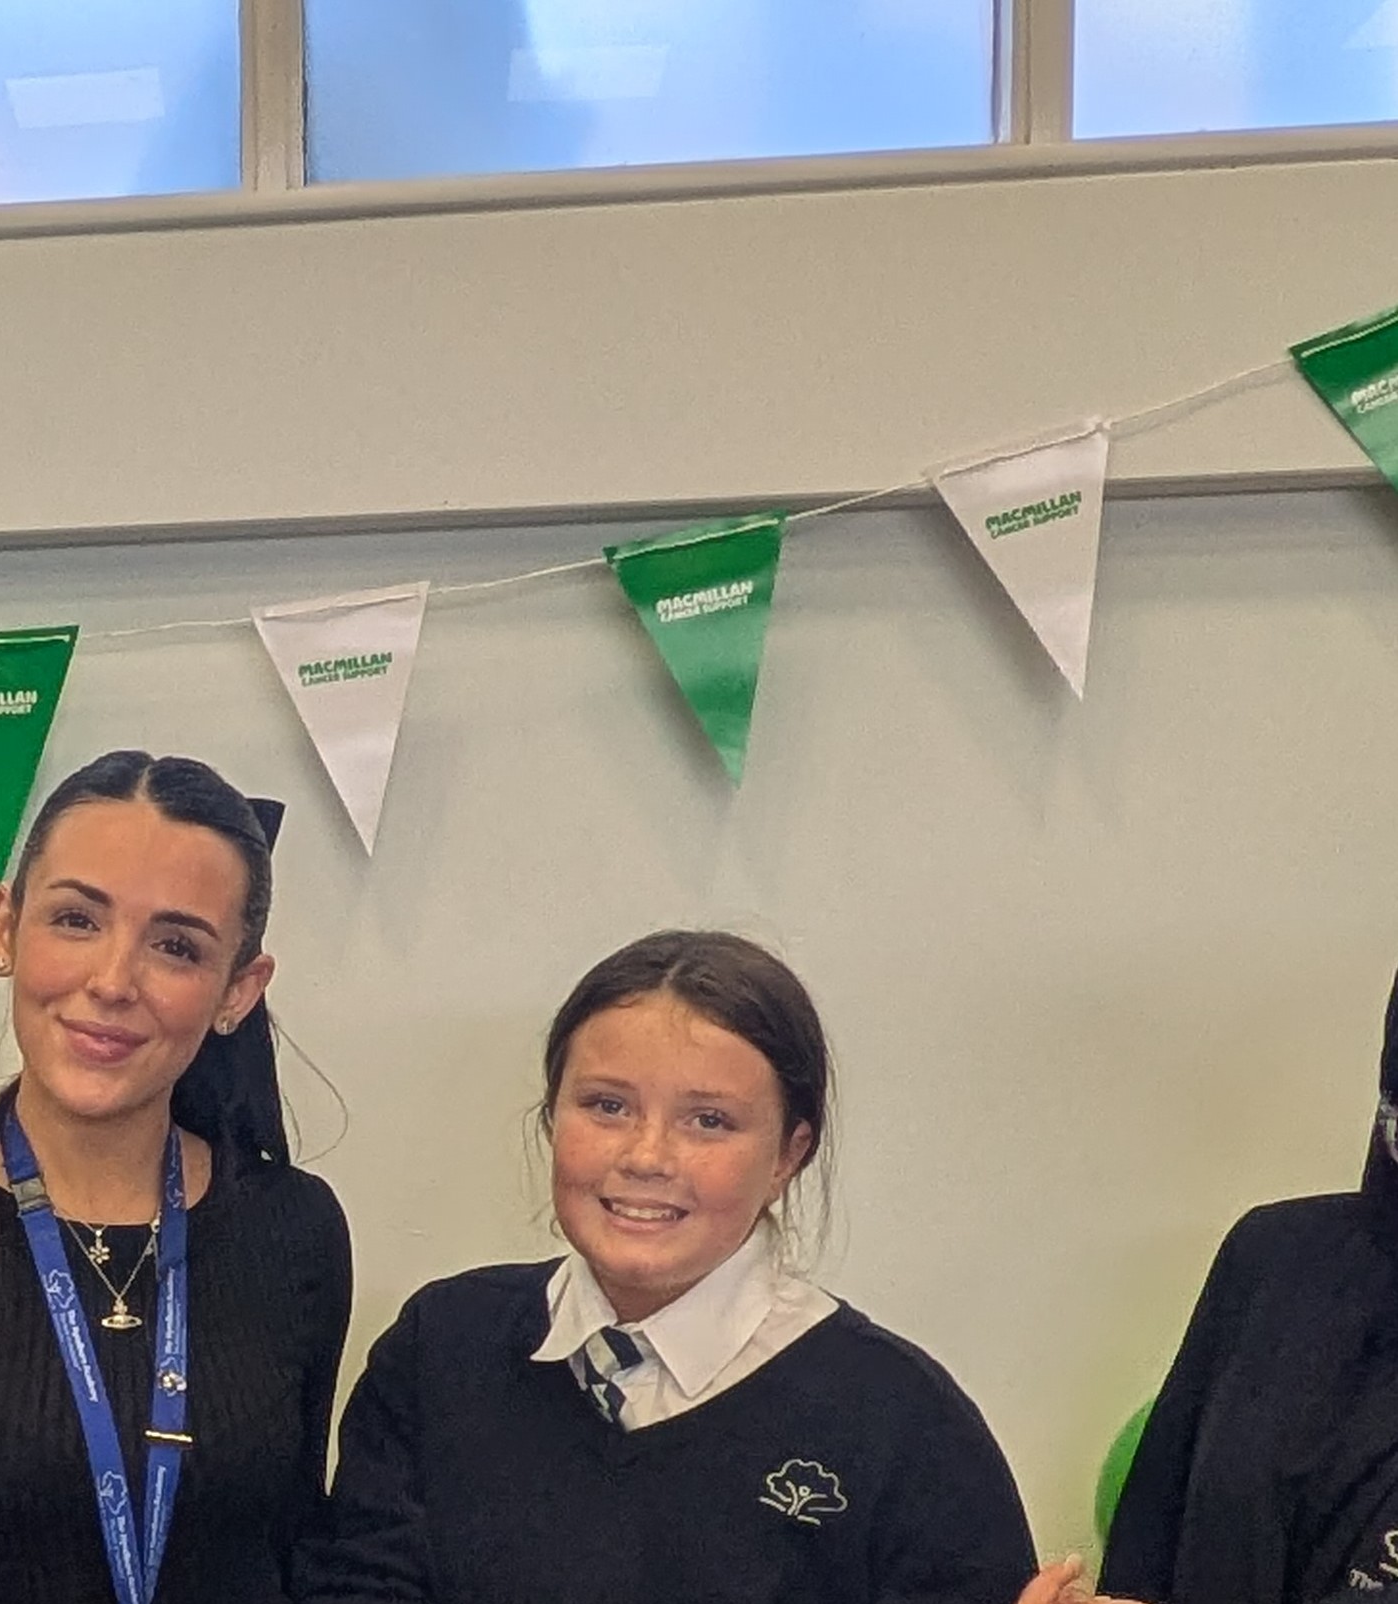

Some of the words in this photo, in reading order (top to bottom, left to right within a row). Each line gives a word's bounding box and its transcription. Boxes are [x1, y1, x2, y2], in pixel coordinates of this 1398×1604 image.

[986, 490, 1082, 531] MACMILLAN
[656, 580, 753, 614] MACMILLAN
[299, 651, 392, 678] MACMILLAN
